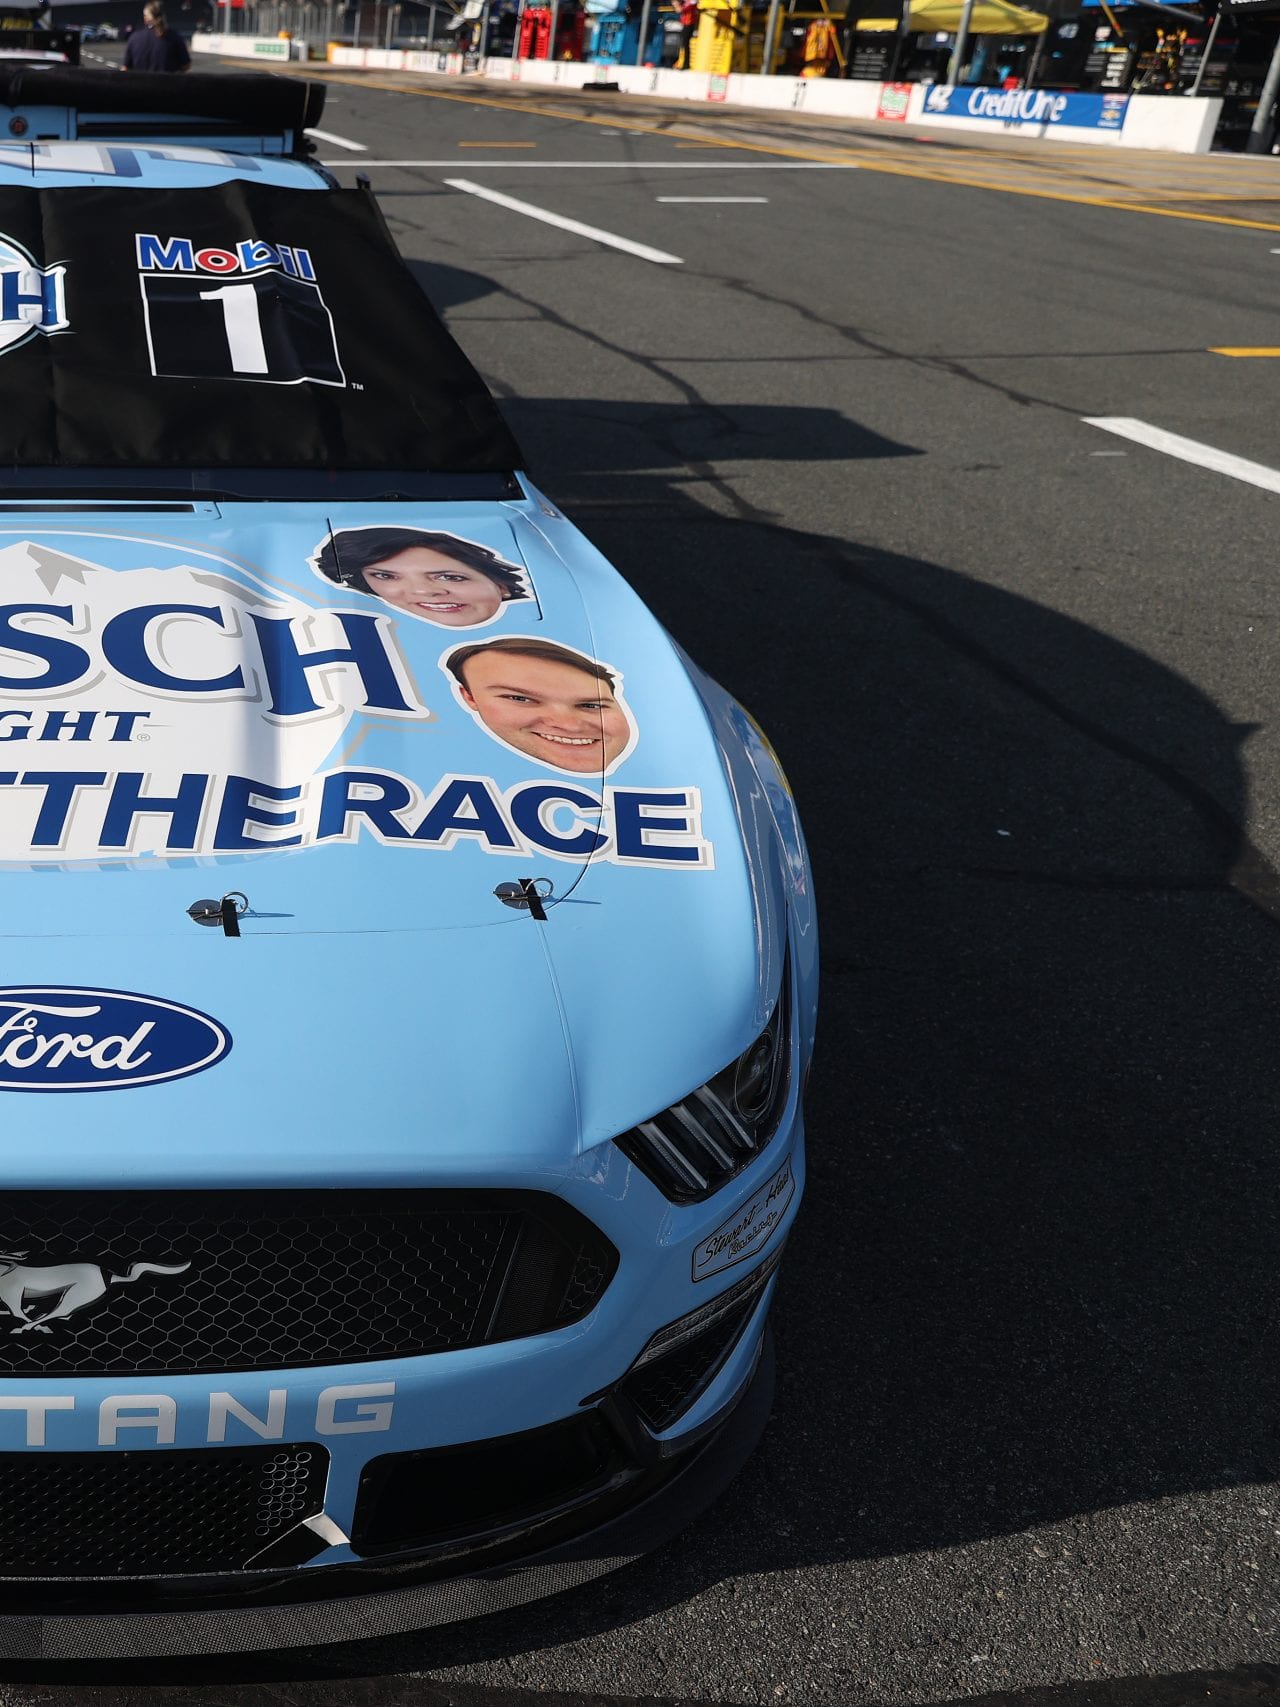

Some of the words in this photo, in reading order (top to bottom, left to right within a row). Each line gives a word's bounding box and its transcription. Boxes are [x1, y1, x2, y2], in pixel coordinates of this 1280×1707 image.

[135, 233, 317, 282] Mobil
[199, 283, 269, 374] 1
[351, 382, 365, 391] TM
